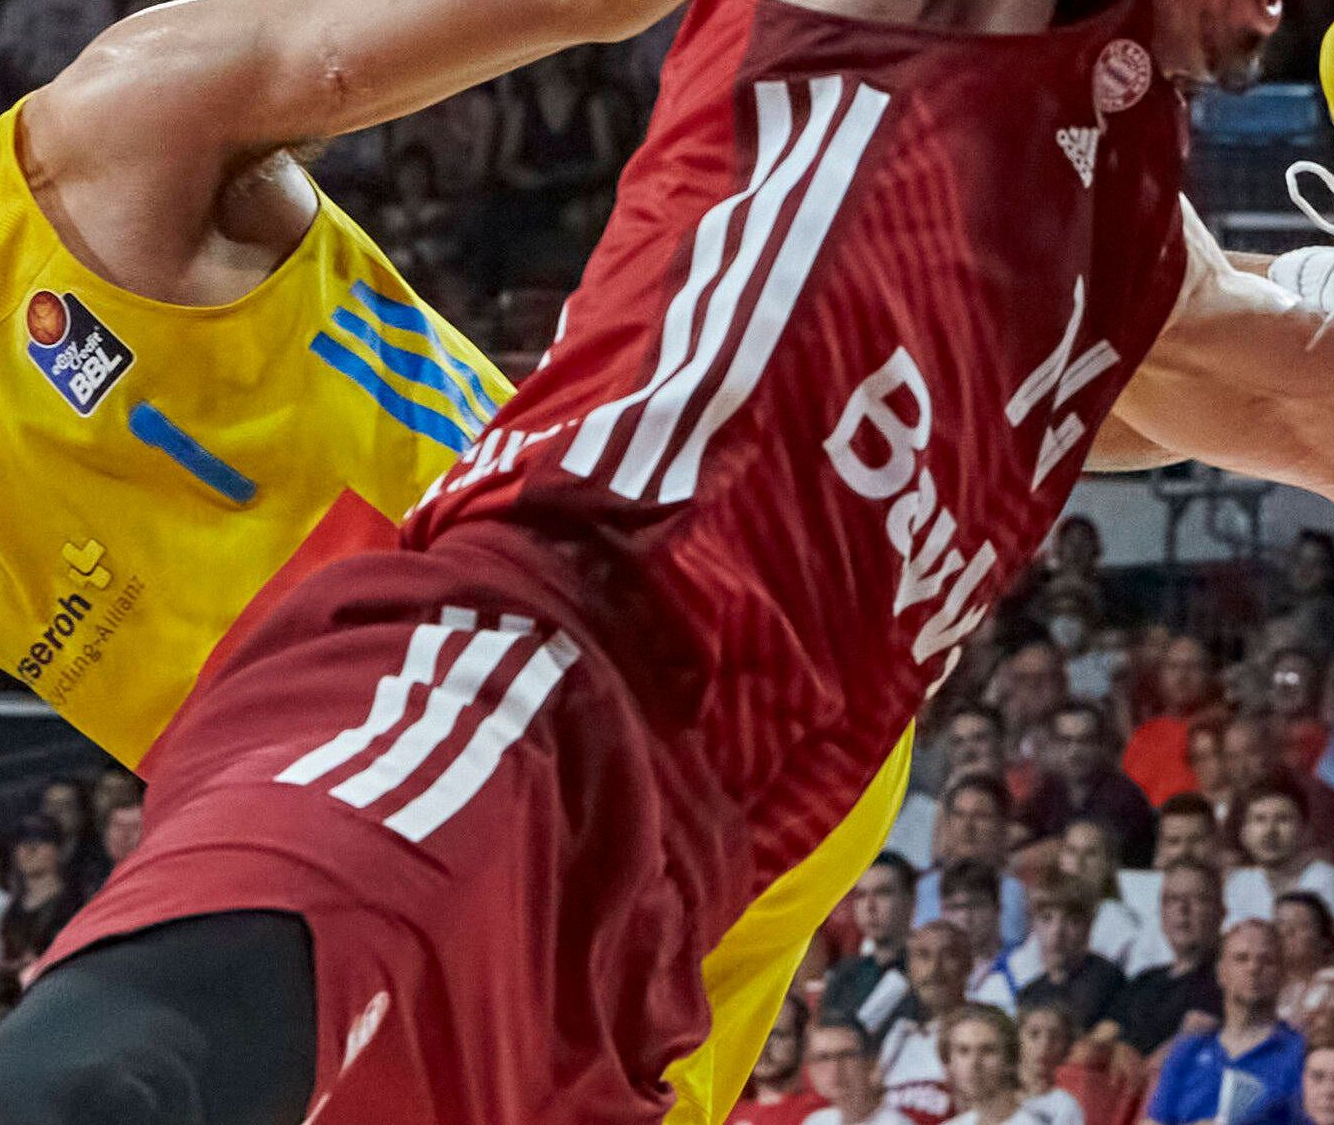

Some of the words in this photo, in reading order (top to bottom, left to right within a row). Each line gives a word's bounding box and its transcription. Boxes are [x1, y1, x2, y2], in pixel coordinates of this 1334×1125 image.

[68, 346, 123, 406] BBL
[128, 401, 257, 504] 1
[17, 594, 92, 681] seroh
[51, 575, 146, 704] ycling-Allianz
